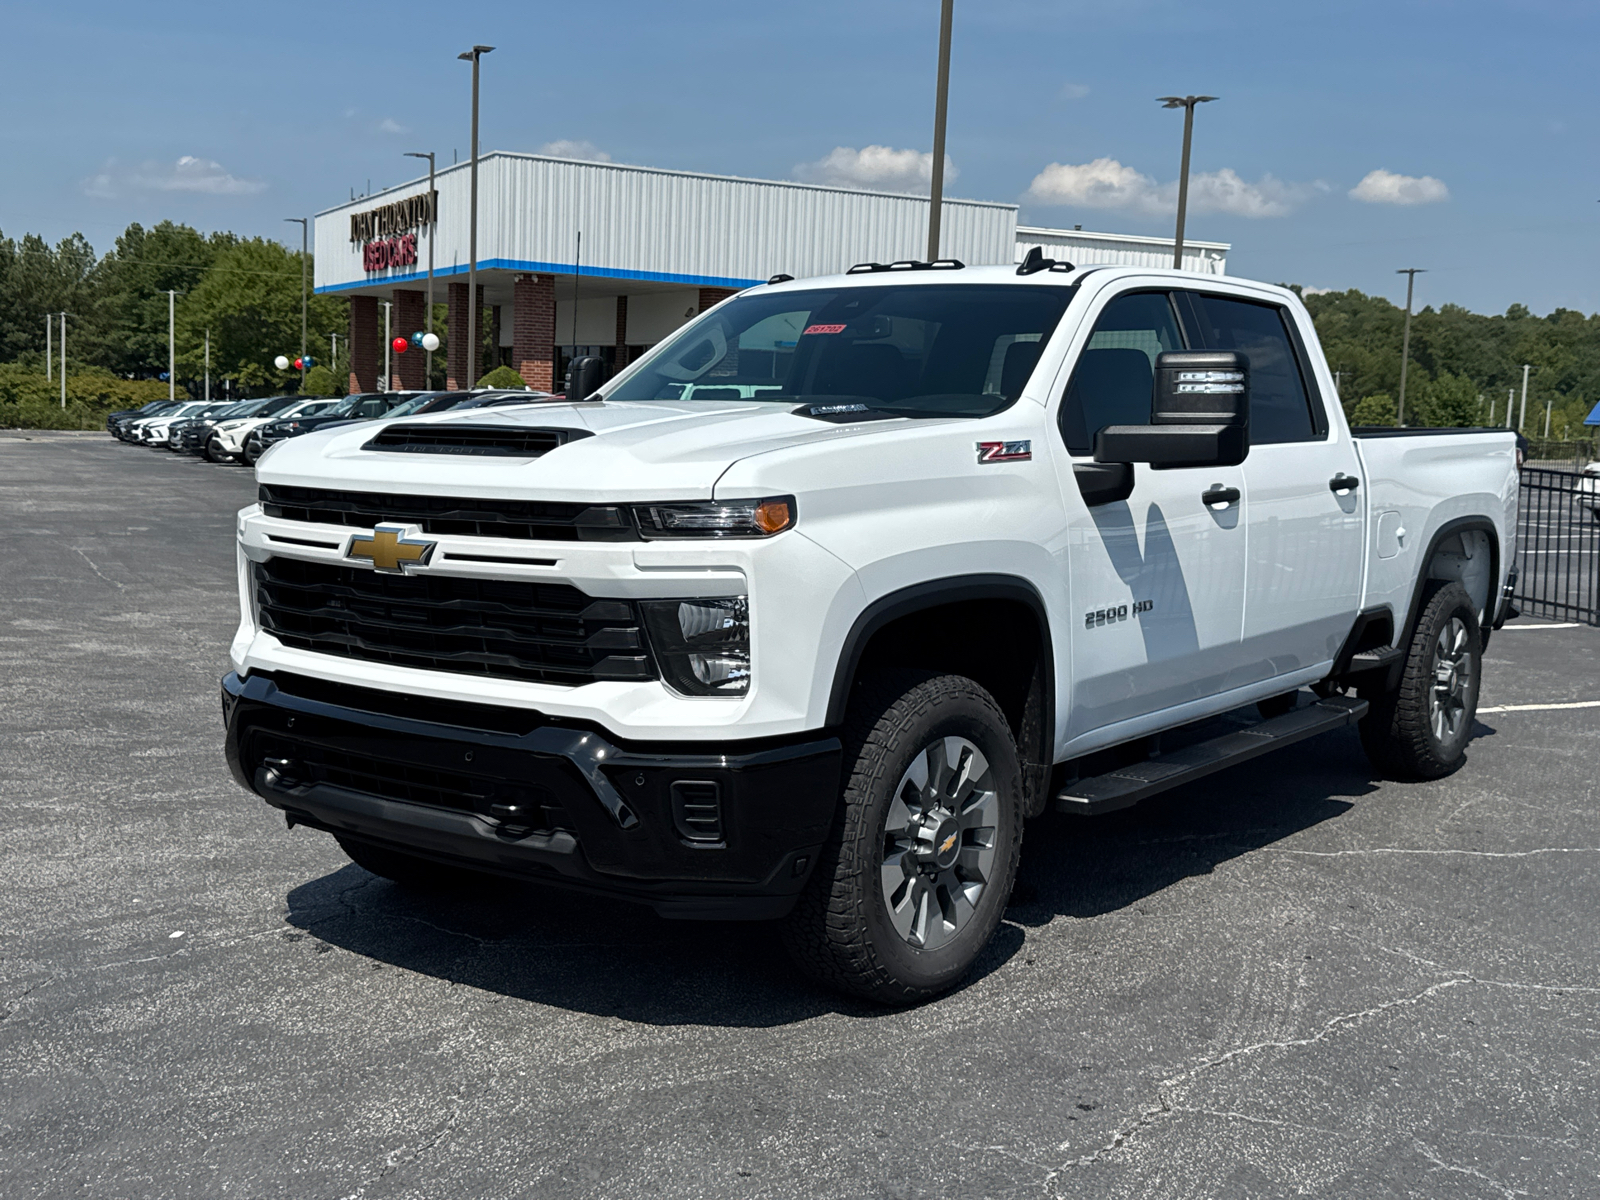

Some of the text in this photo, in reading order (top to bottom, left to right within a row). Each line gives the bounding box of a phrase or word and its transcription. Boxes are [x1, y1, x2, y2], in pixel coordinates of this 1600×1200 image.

[350, 190, 438, 242] JOHN THORNTON
[363, 233, 417, 272] USED CARS
[976, 440, 1031, 464] Z71
[1085, 600, 1153, 625] 2500 HD
